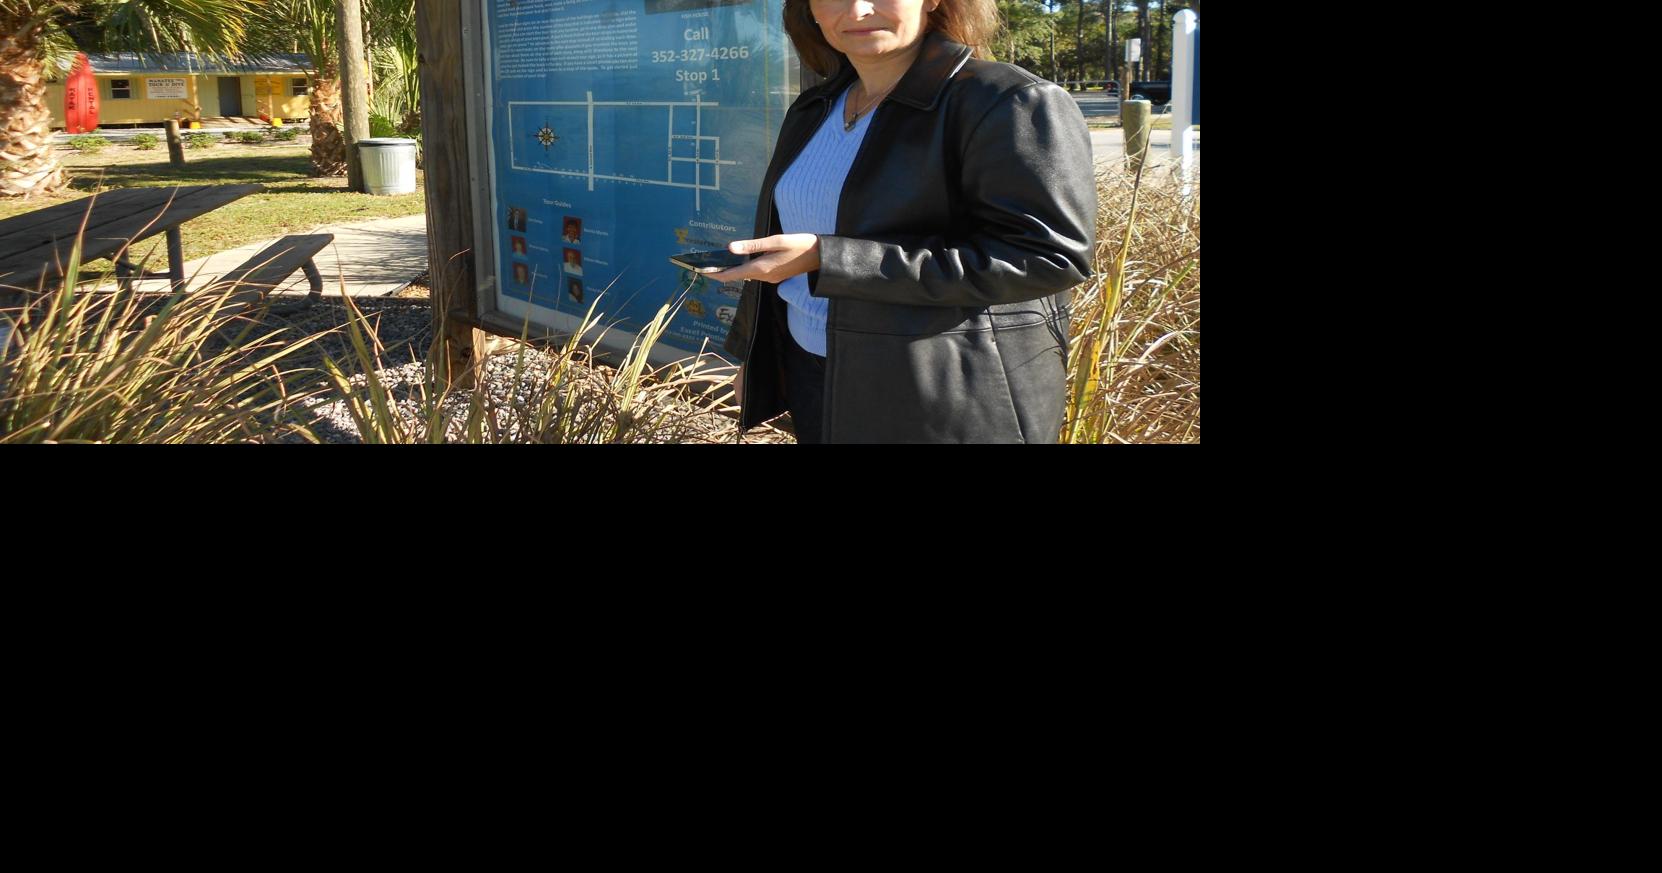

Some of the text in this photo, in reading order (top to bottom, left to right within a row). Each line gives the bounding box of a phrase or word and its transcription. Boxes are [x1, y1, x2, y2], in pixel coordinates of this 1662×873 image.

[684, 27, 710, 41] Call
[651, 46, 749, 63] 352-327-4266
[675, 69, 720, 84] Stop 1
[688, 220, 737, 232] Contributors
[693, 320, 719, 331] Printed
